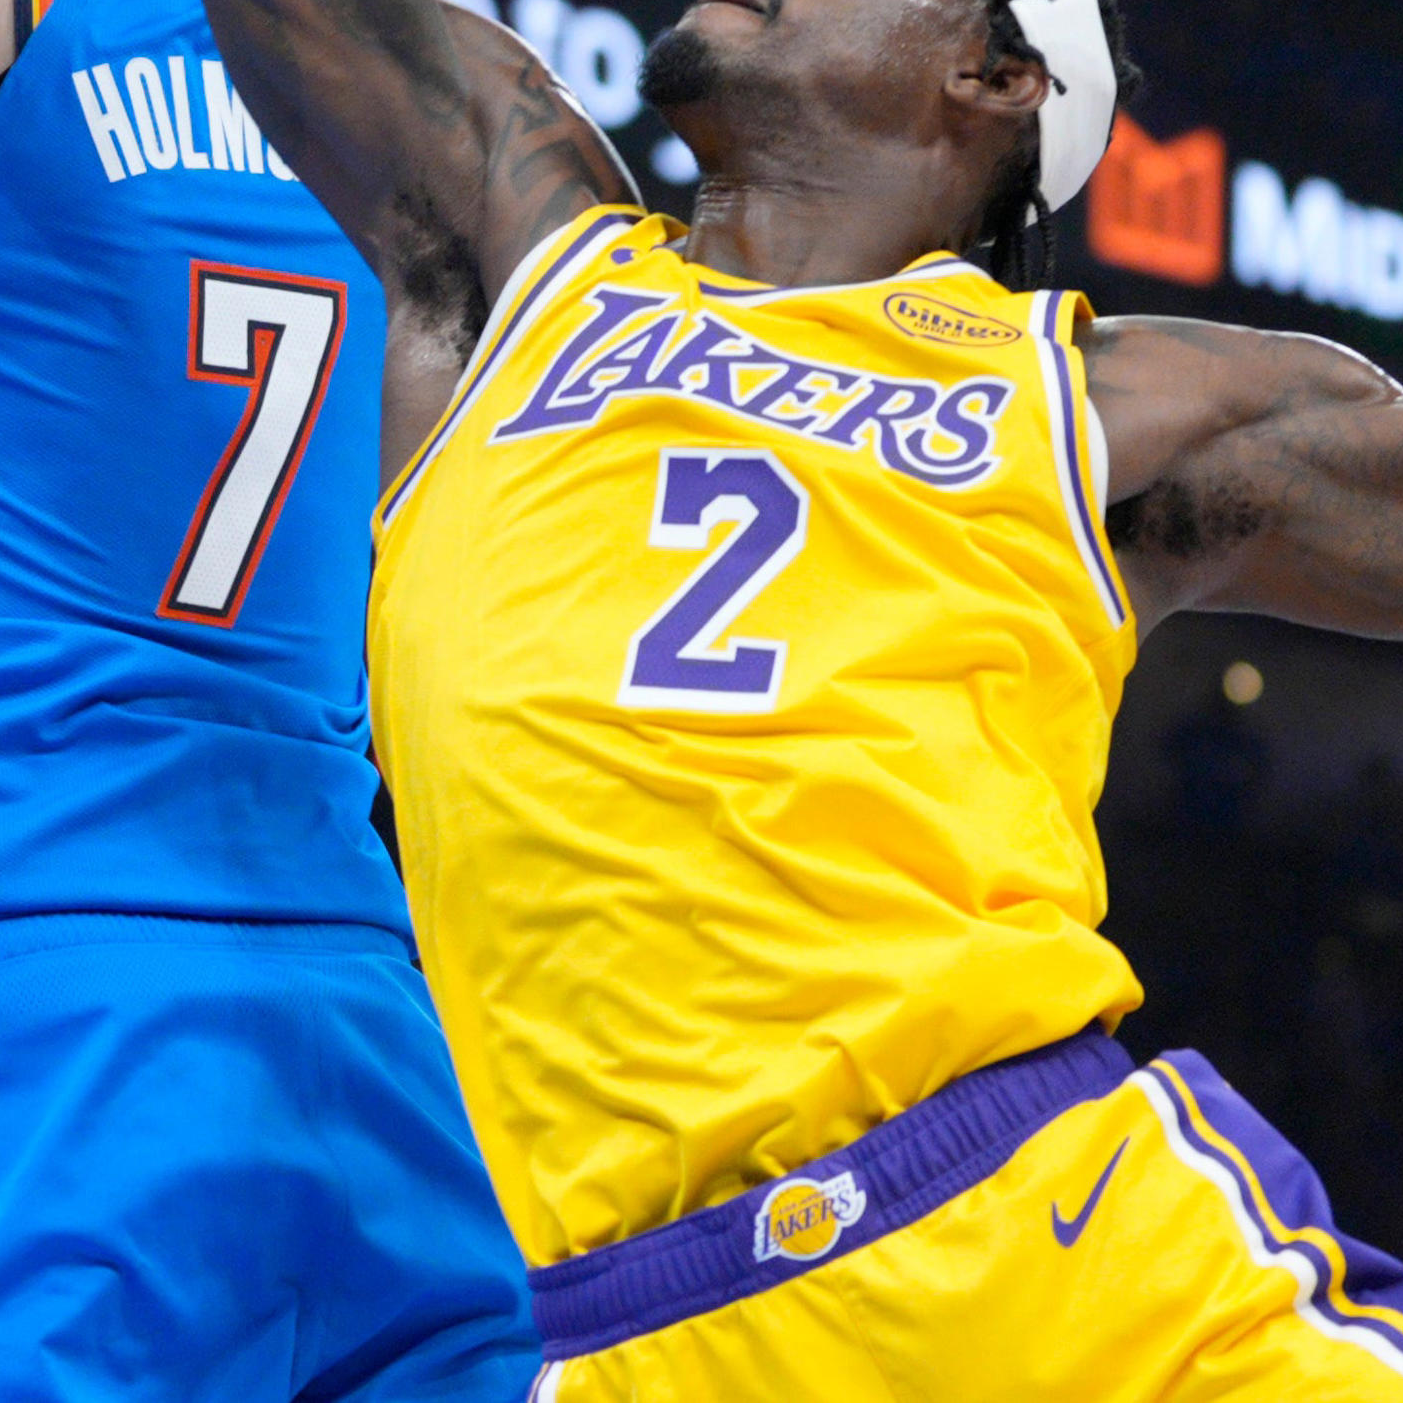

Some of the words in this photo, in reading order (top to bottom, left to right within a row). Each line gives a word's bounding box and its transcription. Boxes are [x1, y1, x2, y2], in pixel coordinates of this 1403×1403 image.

[71, 55, 300, 183] HOLM
[486, 282, 1017, 491] LAKERS
[897, 300, 1013, 340] bibigo
[155, 258, 348, 629] 7
[616, 447, 810, 713] 2
[756, 1190, 861, 1259] LAKERS
